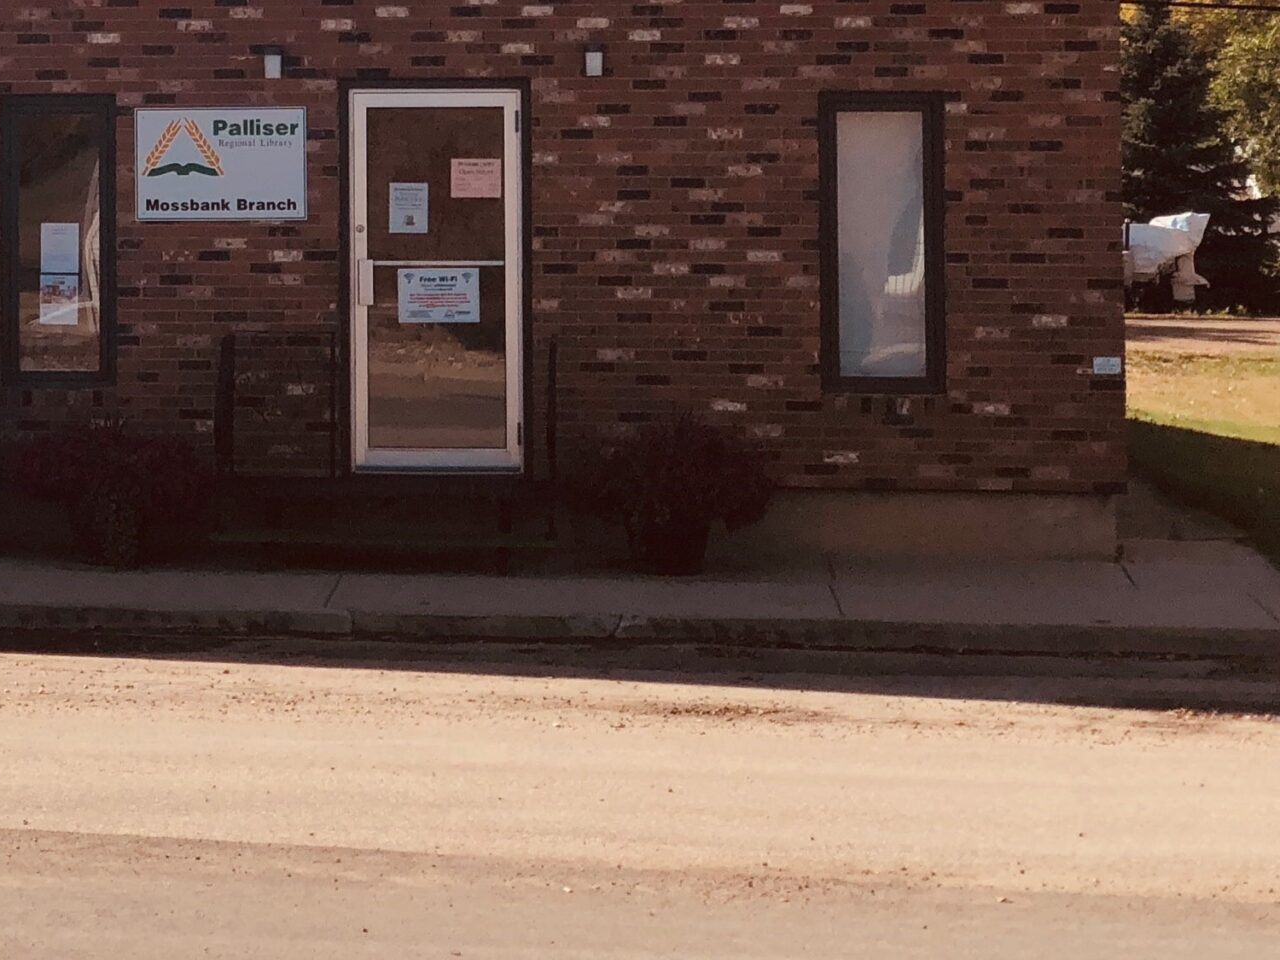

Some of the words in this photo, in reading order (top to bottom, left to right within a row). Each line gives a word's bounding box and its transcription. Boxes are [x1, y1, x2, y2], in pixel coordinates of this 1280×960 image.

[213, 119, 299, 136] Palliser
[219, 139, 256, 149] Regional
[260, 139, 293, 149] Library
[145, 199, 230, 211] Mossbank
[237, 199, 297, 211] Branch
